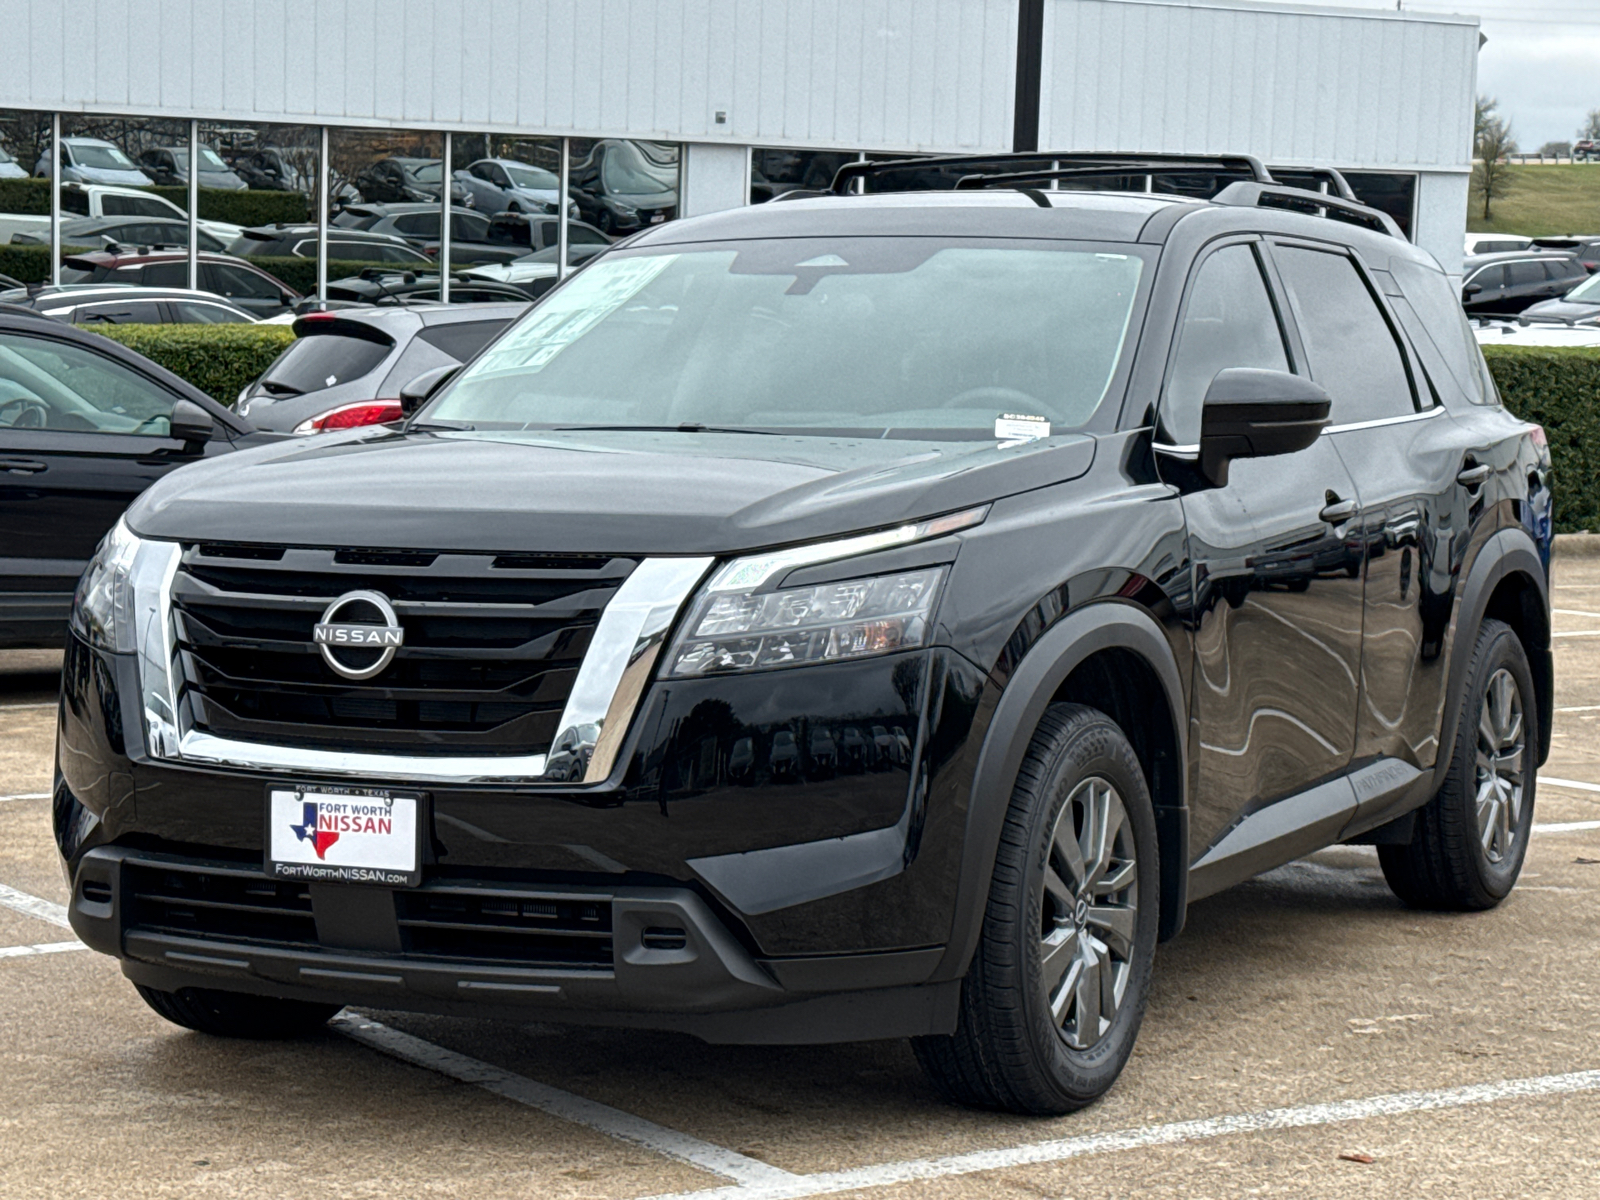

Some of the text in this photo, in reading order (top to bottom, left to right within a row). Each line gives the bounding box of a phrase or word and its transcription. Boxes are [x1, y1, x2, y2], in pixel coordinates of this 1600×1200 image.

[315, 627, 401, 644] NISSAN
[295, 785, 390, 798] FORT WORTH TEXAS
[319, 803, 392, 817] FORT WORTH
[319, 814, 392, 835] NISSAN
